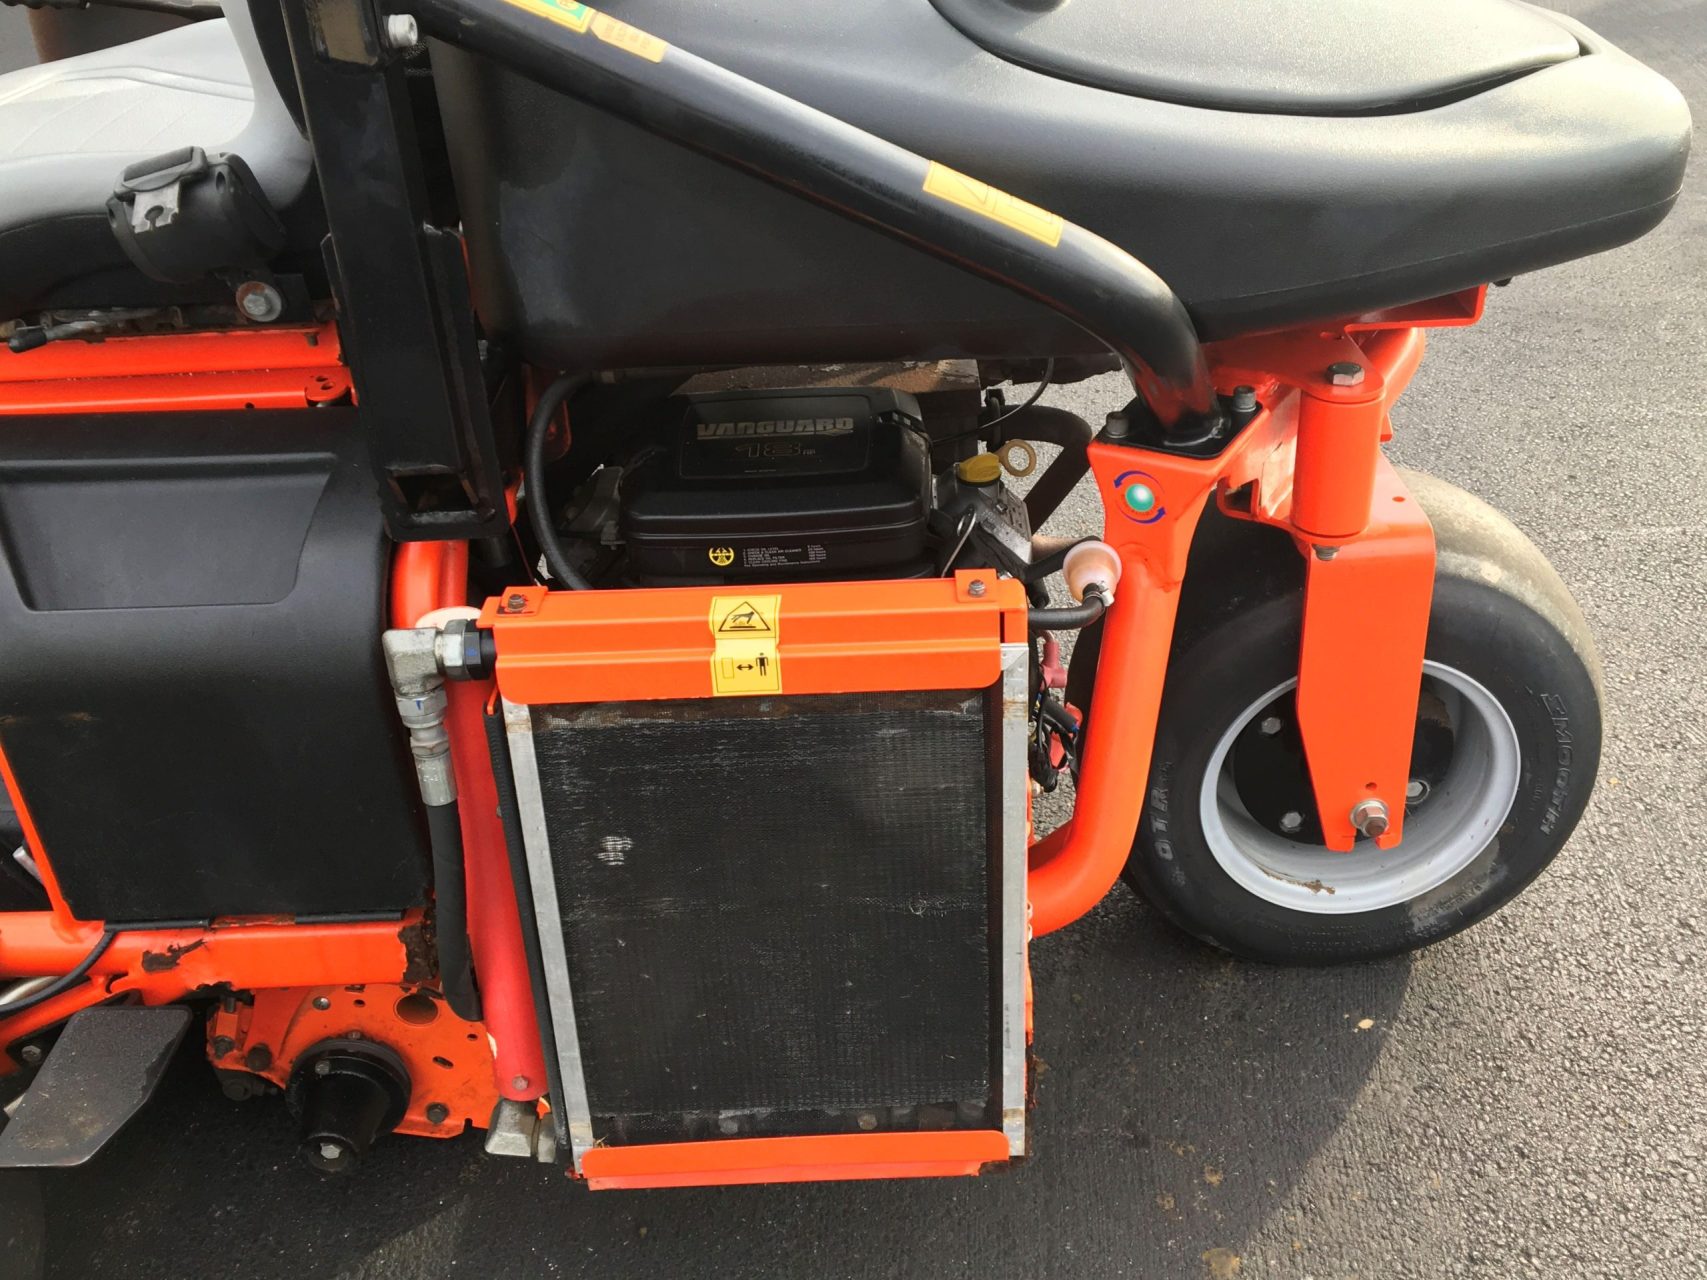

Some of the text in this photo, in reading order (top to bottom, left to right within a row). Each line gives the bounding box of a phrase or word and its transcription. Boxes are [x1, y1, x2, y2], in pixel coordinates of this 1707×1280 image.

[697, 418, 854, 436] VANGUARD
[1540, 693, 1574, 835] SMOOTH
[1151, 787, 1174, 861] OTR
